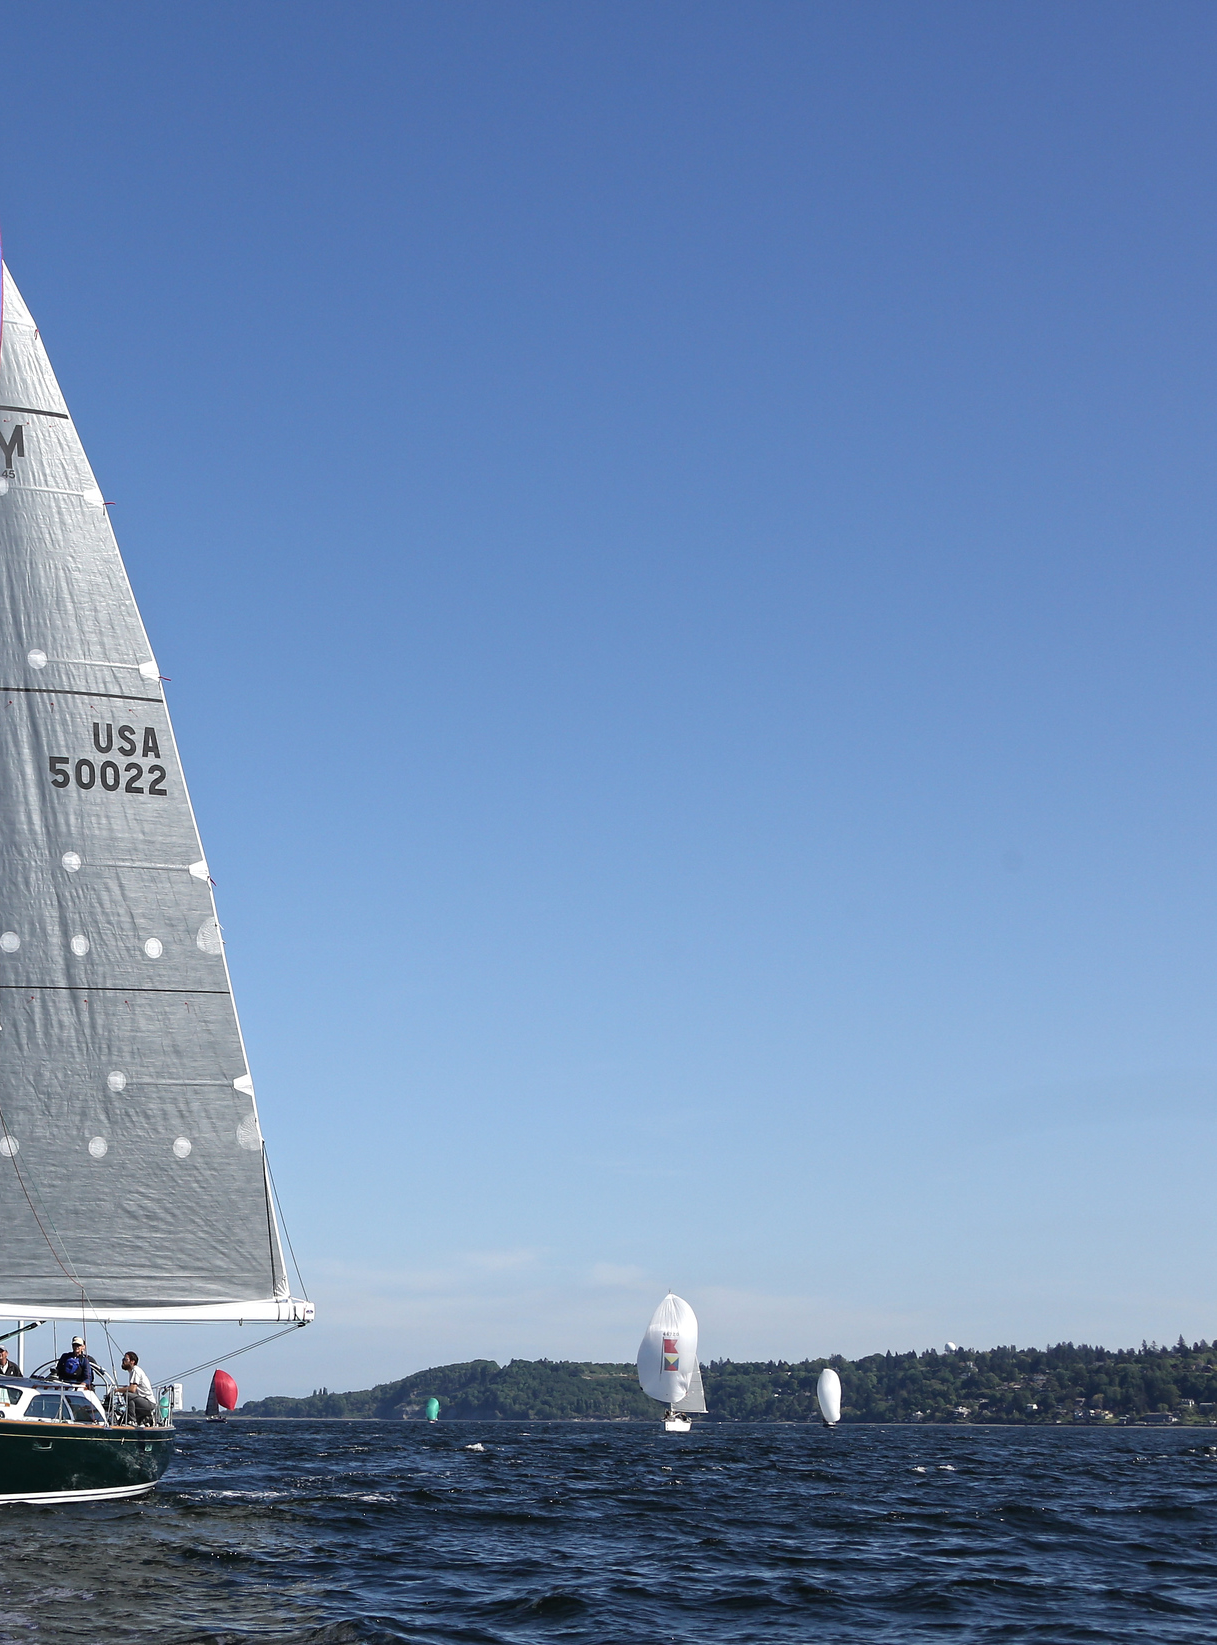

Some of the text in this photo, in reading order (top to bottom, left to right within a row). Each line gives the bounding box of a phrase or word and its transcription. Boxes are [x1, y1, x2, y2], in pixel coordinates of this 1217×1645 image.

[2, 470, 15, 479] 45
[93, 722, 161, 759] USA
[49, 756, 168, 796] 50022
